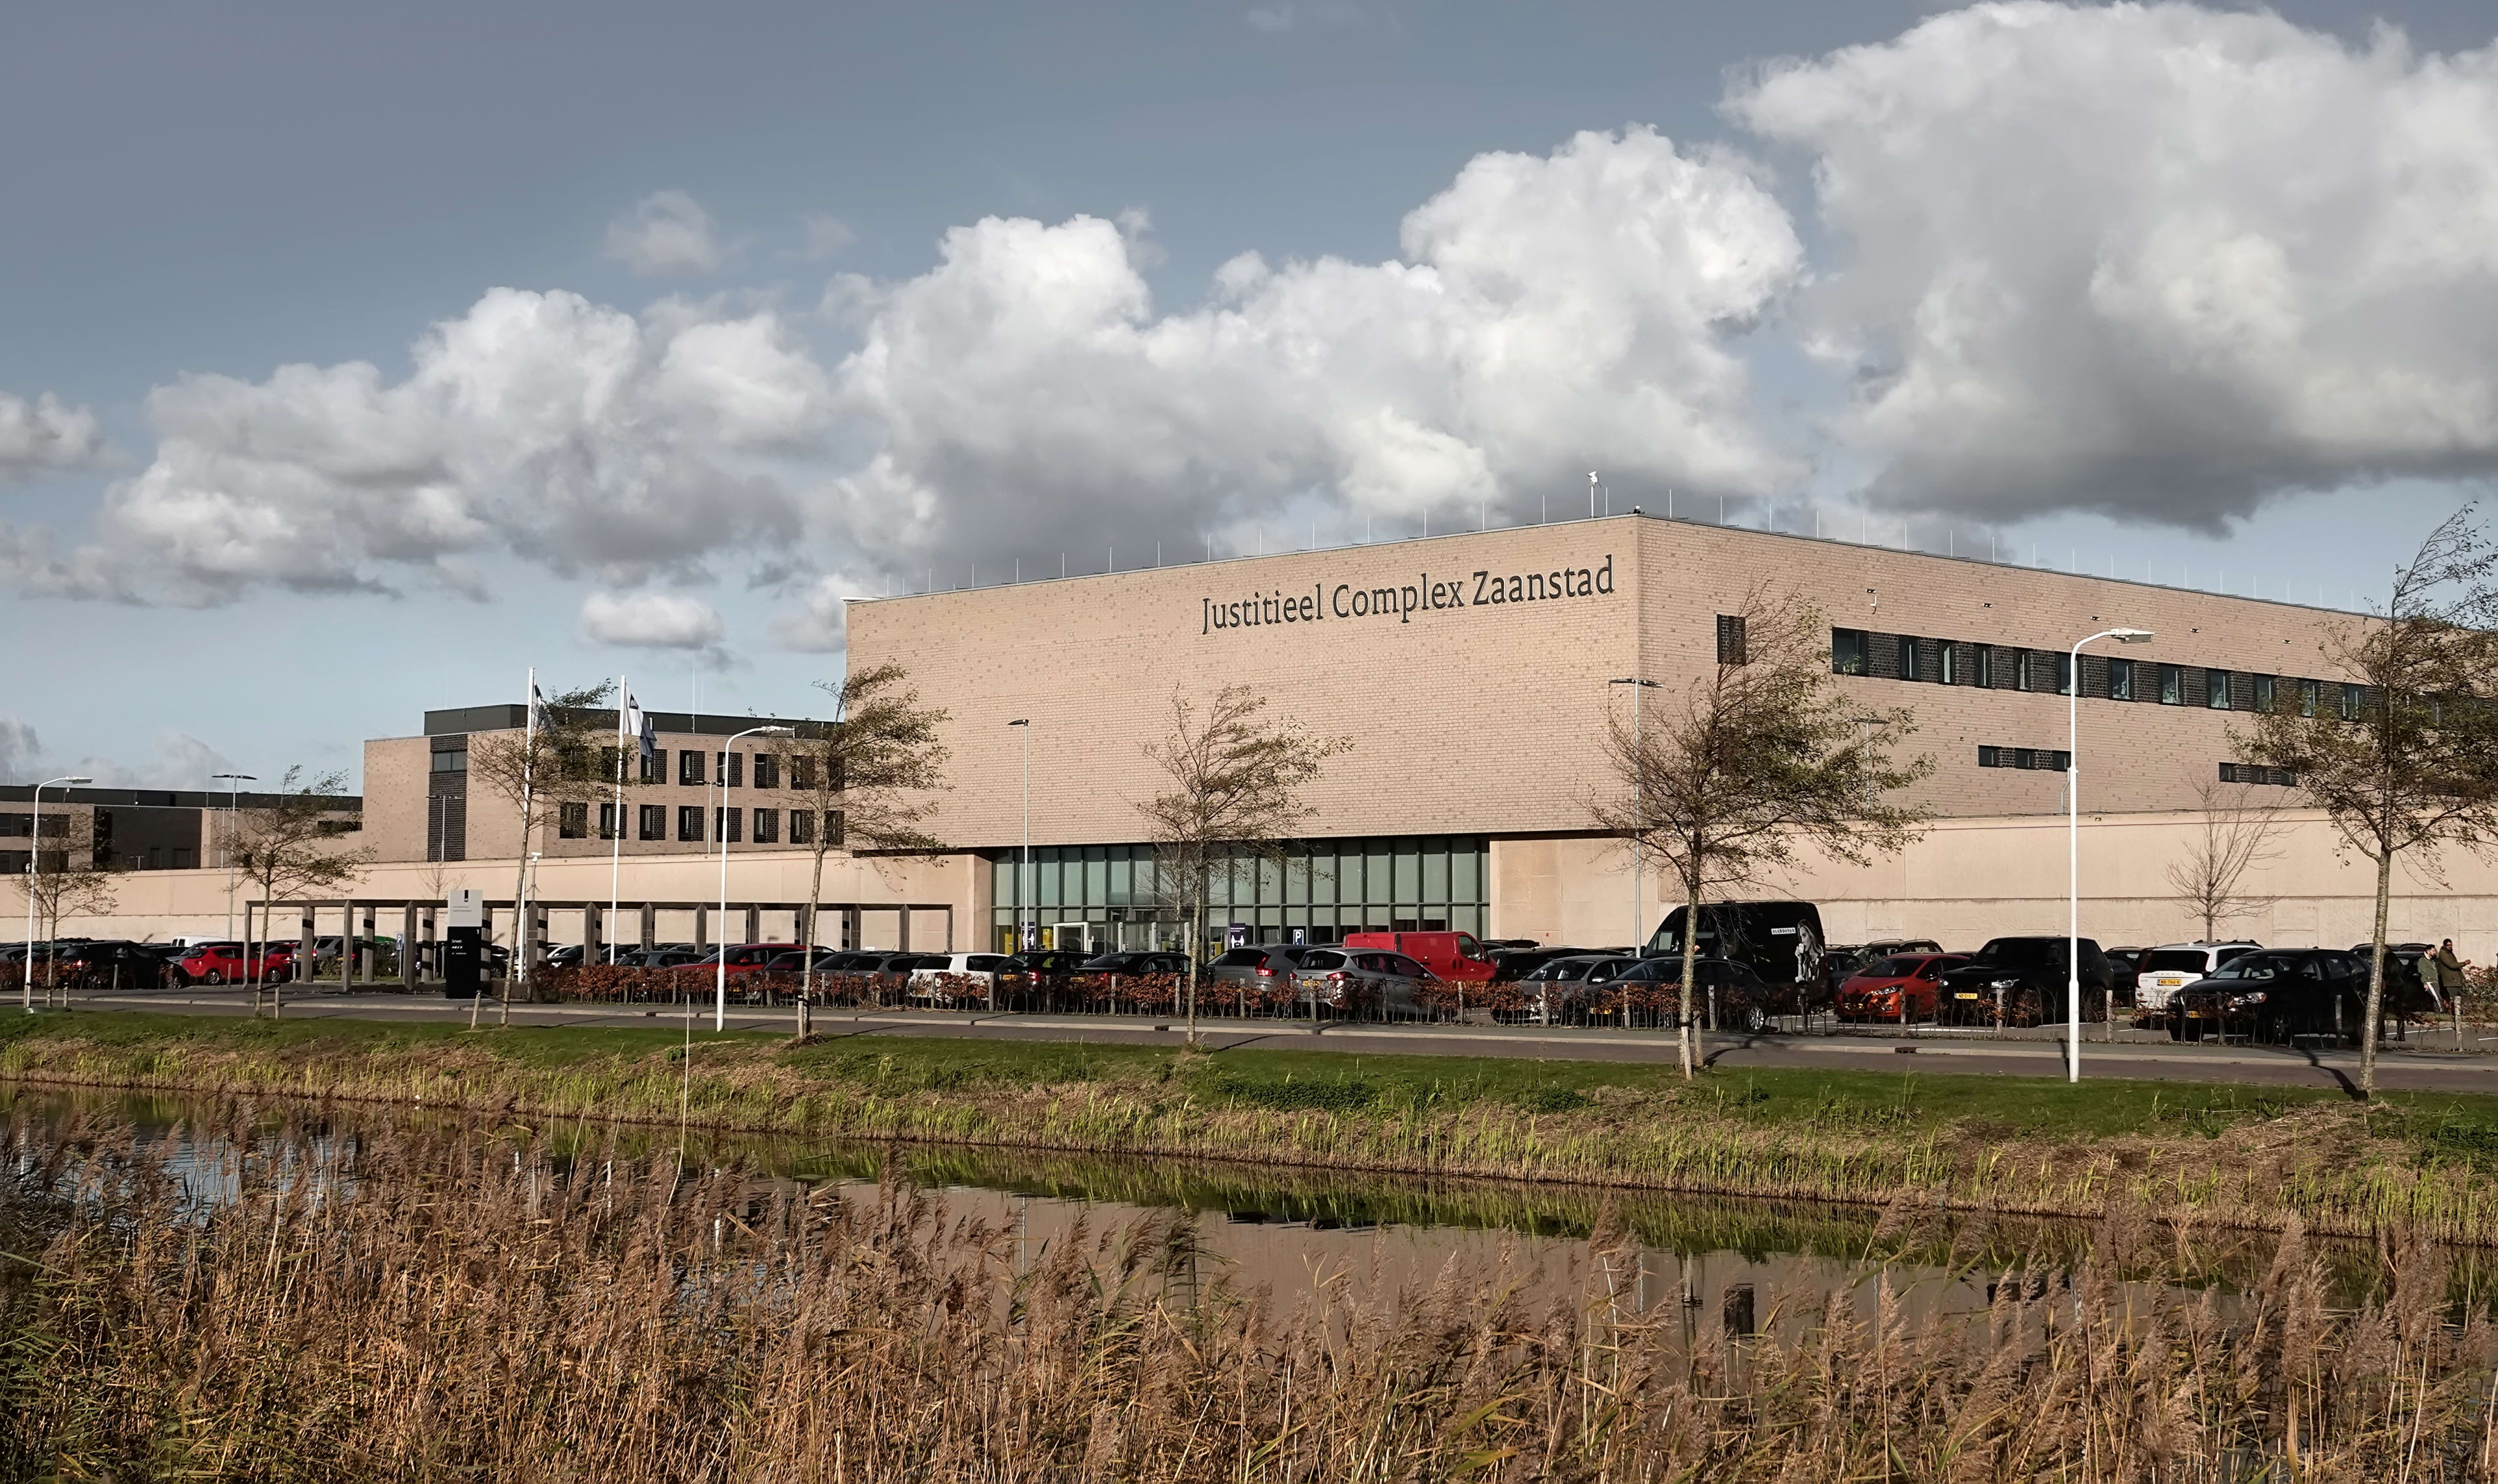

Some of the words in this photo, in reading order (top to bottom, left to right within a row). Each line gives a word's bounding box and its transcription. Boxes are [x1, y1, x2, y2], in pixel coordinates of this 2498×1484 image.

[1202, 583, 1324, 635] Justitieel
[1332, 572, 1465, 622] Complex
[1472, 554, 1615, 605] Zaanstad
[1295, 931, 1302, 942] P
